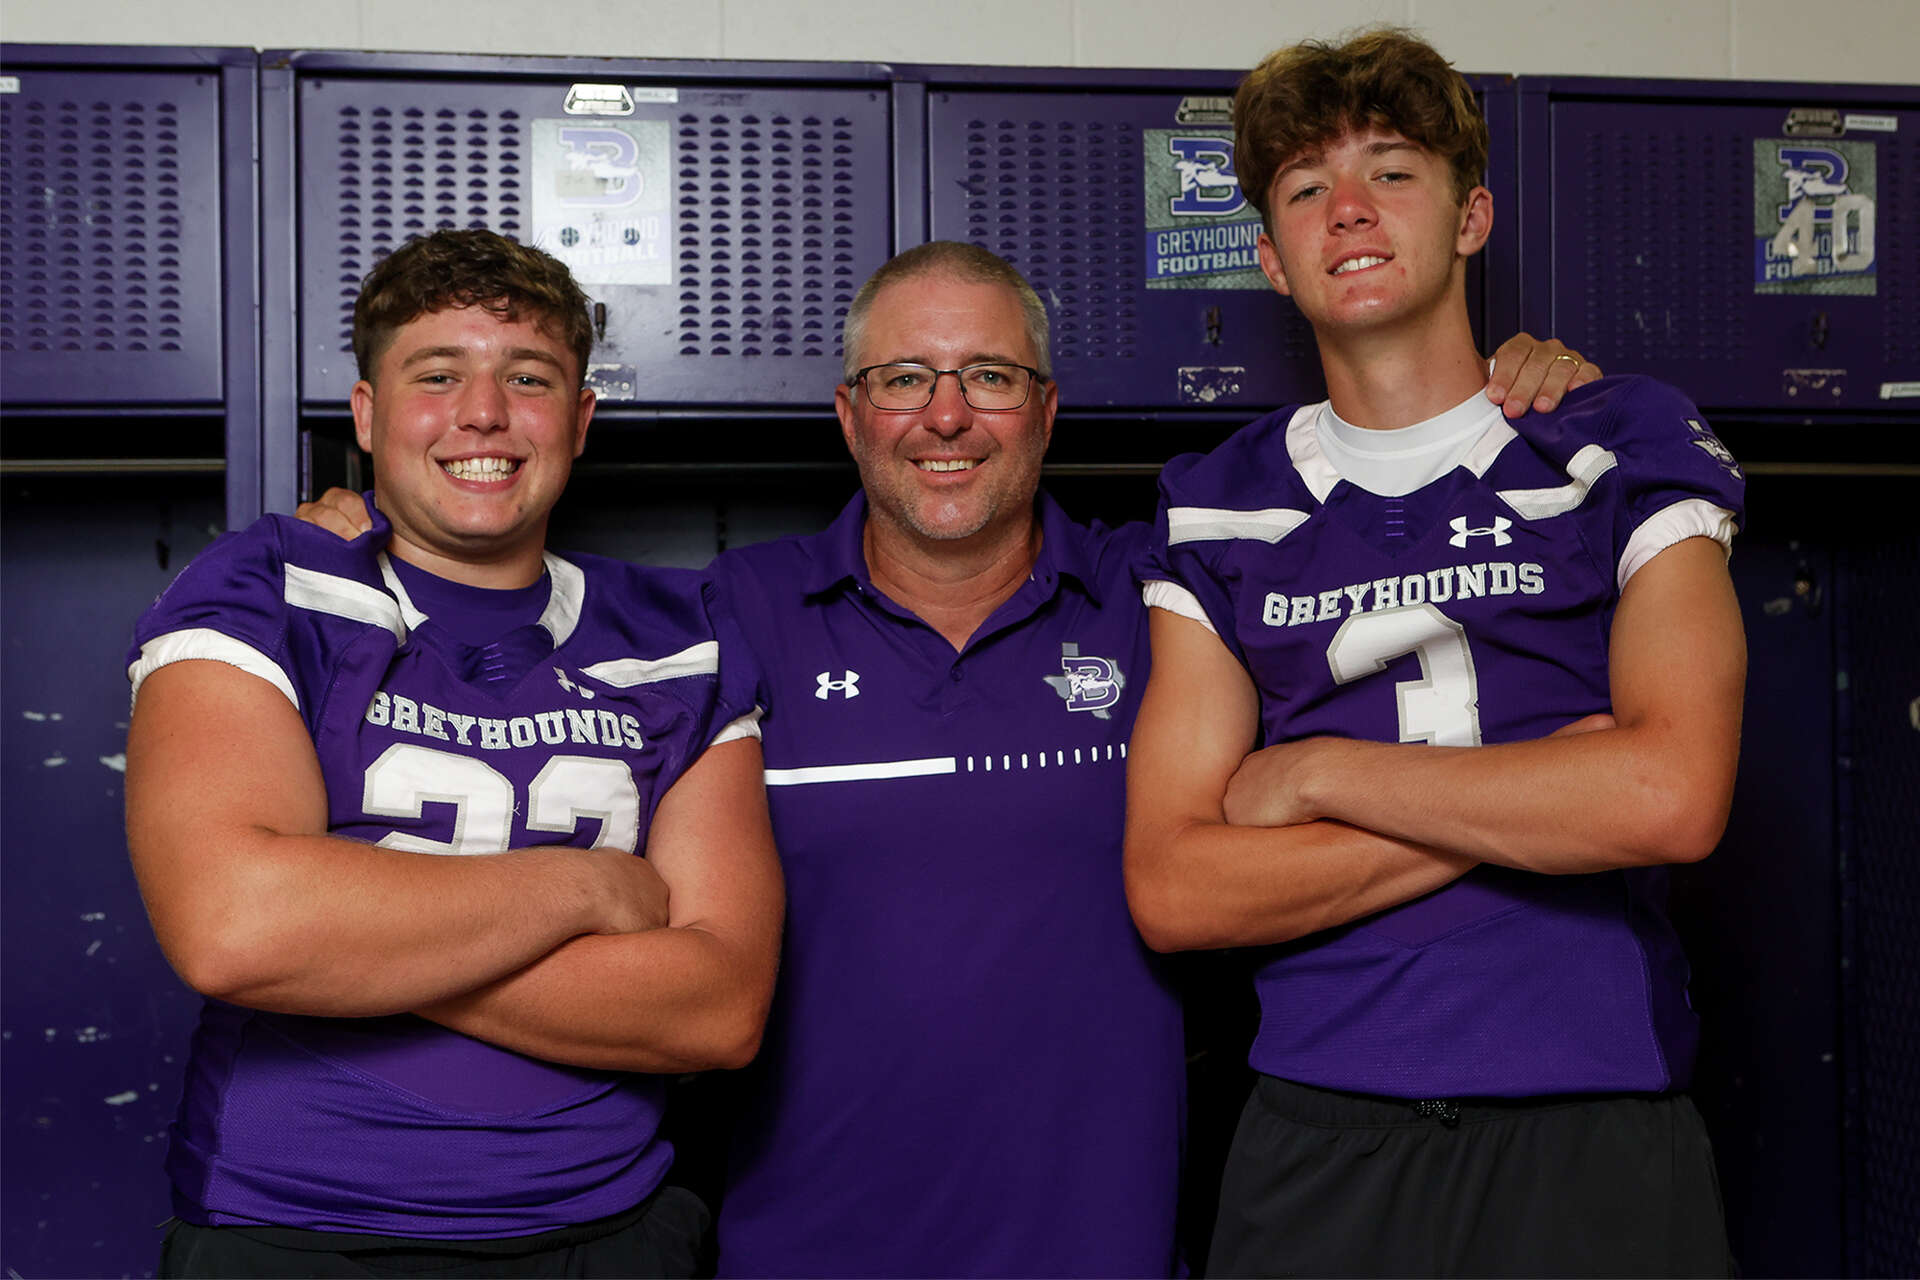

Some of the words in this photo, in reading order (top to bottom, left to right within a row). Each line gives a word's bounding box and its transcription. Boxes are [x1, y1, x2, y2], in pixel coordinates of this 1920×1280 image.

[1169, 136, 1249, 216] B
[1773, 193, 1876, 277] 40
[1262, 562, 1545, 627] GREYHOUNDS
[1326, 603, 1482, 748] 3
[365, 691, 644, 750] GREYHOUNDS
